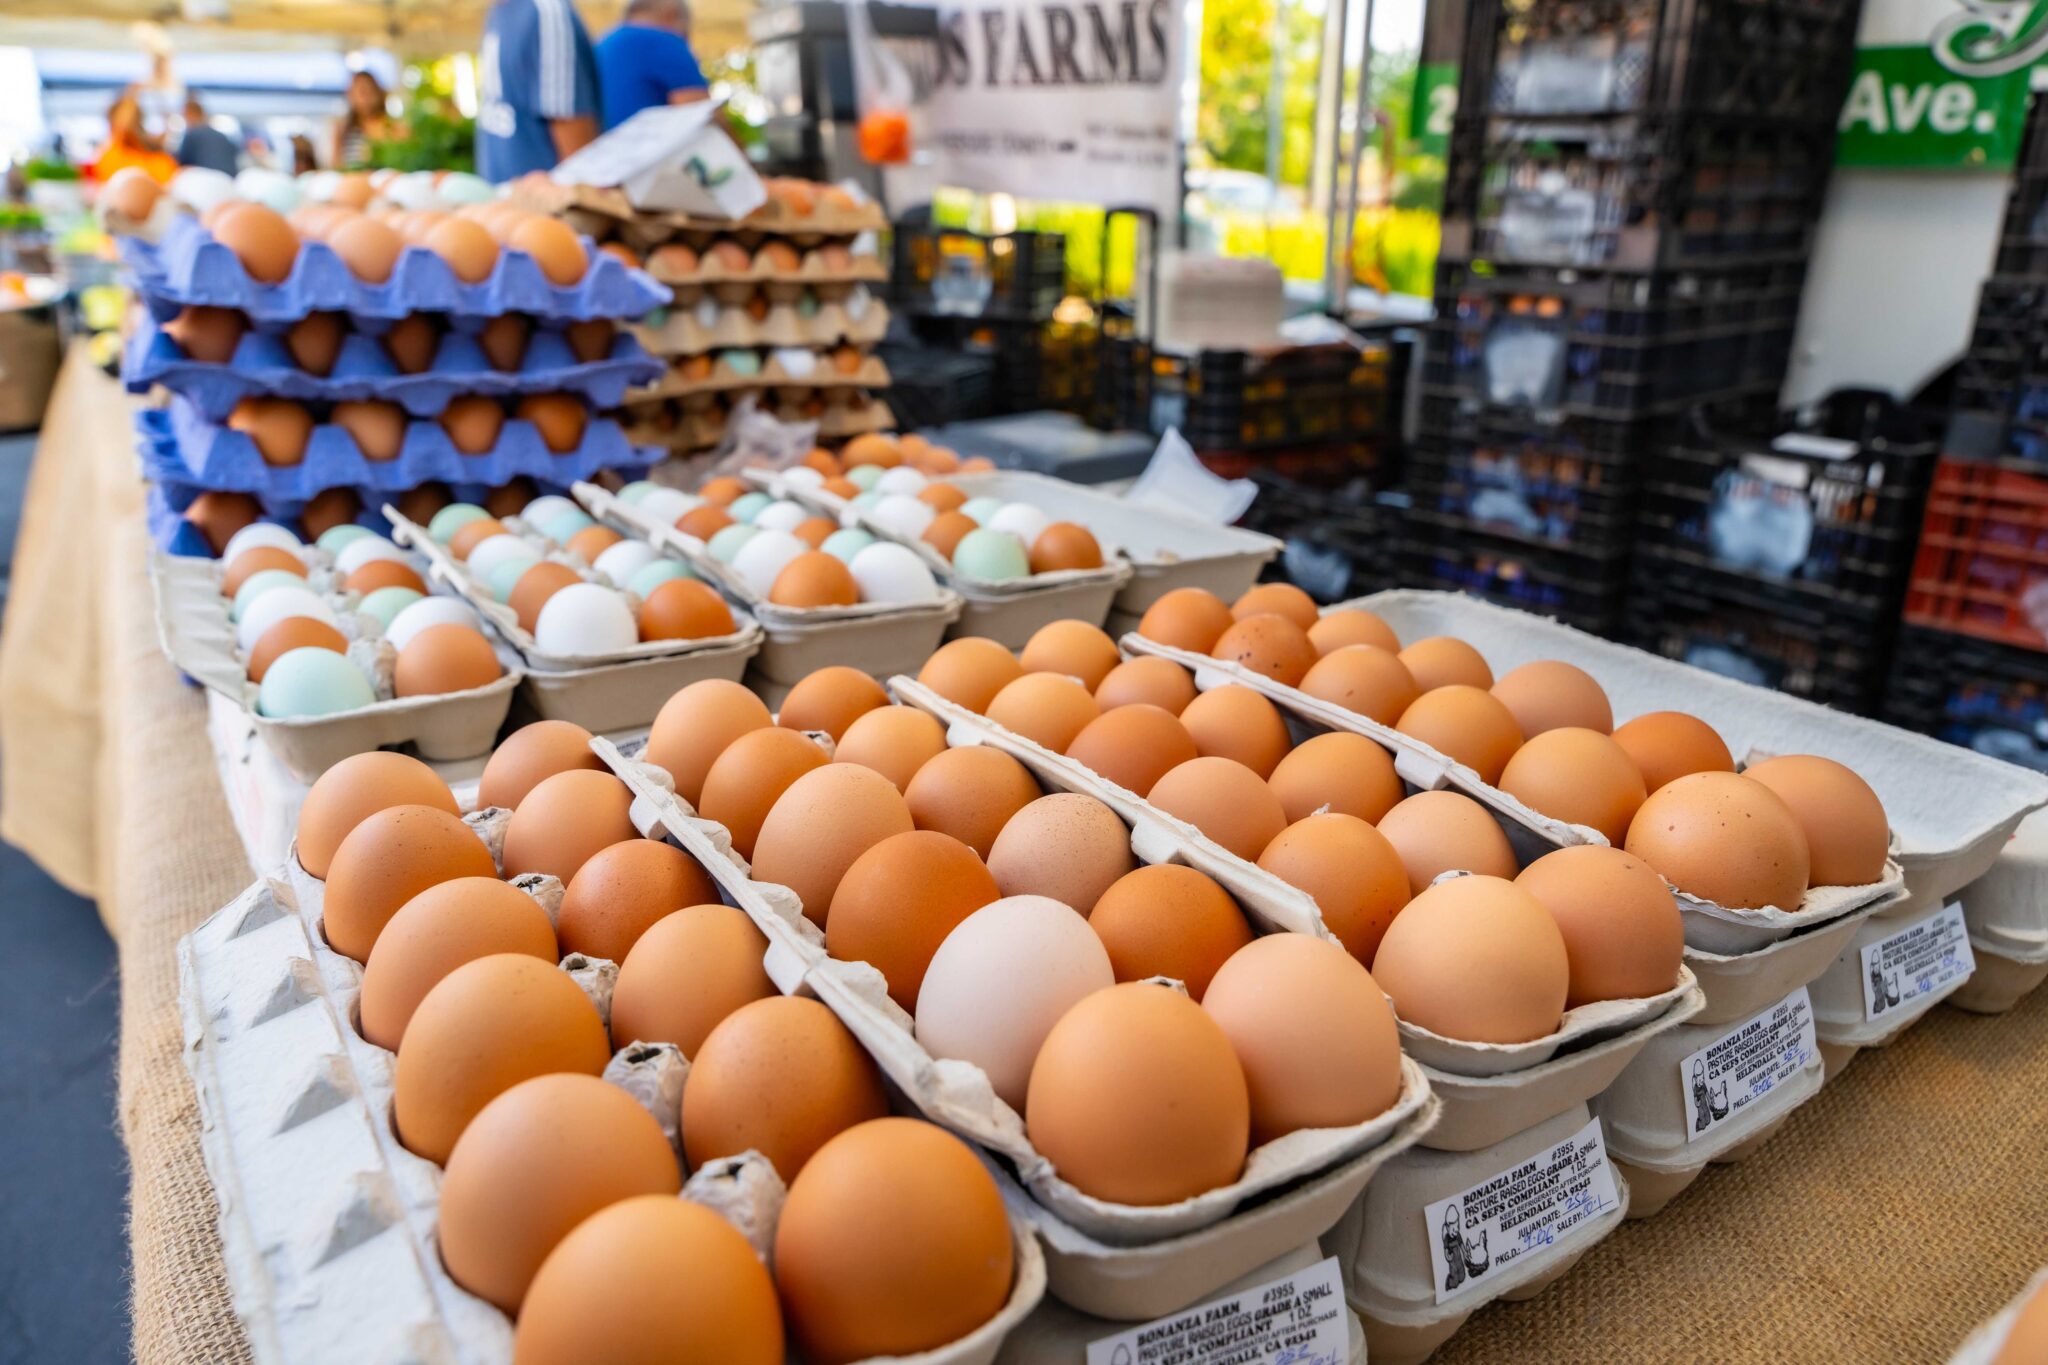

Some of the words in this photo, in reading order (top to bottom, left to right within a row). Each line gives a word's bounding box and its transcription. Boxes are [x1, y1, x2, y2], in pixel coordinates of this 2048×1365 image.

[979, 1, 1168, 87] FARMS
[1837, 69, 1995, 134] Ave.
[1884, 961, 1892, 970] CA
[1706, 1033, 1741, 1060] BONANZA
[1741, 1020, 1761, 1039] FARM
[1707, 1048, 1734, 1071] PASTURE
[1734, 1036, 1754, 1056] RAISED
[1754, 1027, 1768, 1043] EGGS
[1768, 1014, 1787, 1033] GRADE
[1788, 1012, 1793, 1021] A
[1709, 1068, 1720, 1080] CA
[1721, 1056, 1739, 1073] SEFS
[1740, 1030, 1779, 1061] COMPLIANT
[1736, 1050, 1776, 1082] HELENDALE,
[1776, 1044, 1786, 1055] CA
[1749, 1071, 1767, 1088] JULIAN
[1778, 1069, 1789, 1080] SALE
[1463, 1175, 1510, 1206] BONANZA
[1511, 1161, 1537, 1182] FARM
[1552, 1141, 1574, 1161] #3955
[1464, 1193, 1499, 1219] PASTURE
[1500, 1180, 1527, 1201] RAISED
[1527, 1168, 1546, 1188] EGGS
[1546, 1155, 1573, 1177] GRADE
[1574, 1151, 1580, 1163] A
[1579, 1137, 1598, 1158] SMALL
[1465, 1216, 1480, 1229] CA
[1481, 1202, 1506, 1222] SEFS
[1507, 1173, 1560, 1208] COMPLIANT
[1571, 1164, 1575, 1174] 1
[1576, 1157, 1587, 1172] DZ
[1499, 1209, 1516, 1221] KEEP
[1516, 1185, 1560, 1213] REFRIGERATED
[1560, 1175, 1577, 1190] AFTER
[1577, 1158, 1602, 1180] PURCHASE
[1500, 1197, 1556, 1233] HELENDALE,
[1556, 1189, 1569, 1202] CA
[1518, 1219, 1542, 1240] JULIAN
[1542, 1209, 1561, 1228] DATE:
[1557, 1218, 1573, 1233] SALE
[1572, 1211, 1584, 1225] BY:
[1137, 1314, 1201, 1347] BONANZA
[1205, 1300, 1240, 1323] FARM
[1263, 1281, 1295, 1303] #3955
[1138, 1333, 1185, 1362] PASTURE
[1188, 1321, 1225, 1344] RAISED
[1227, 1310, 1253, 1331] EGGS
[1254, 1299, 1291, 1321] GRADE
[1293, 1295, 1301, 1308] A
[1303, 1281, 1333, 1304] SMALL
[1197, 1319, 1272, 1355] COMPLIANT
[1289, 1311, 1294, 1322] 1
[1298, 1304, 1312, 1320] DZ
[1271, 1324, 1297, 1339] AFTER
[1298, 1308, 1338, 1329] PURCHASE
[1265, 1339, 1281, 1353] CA
